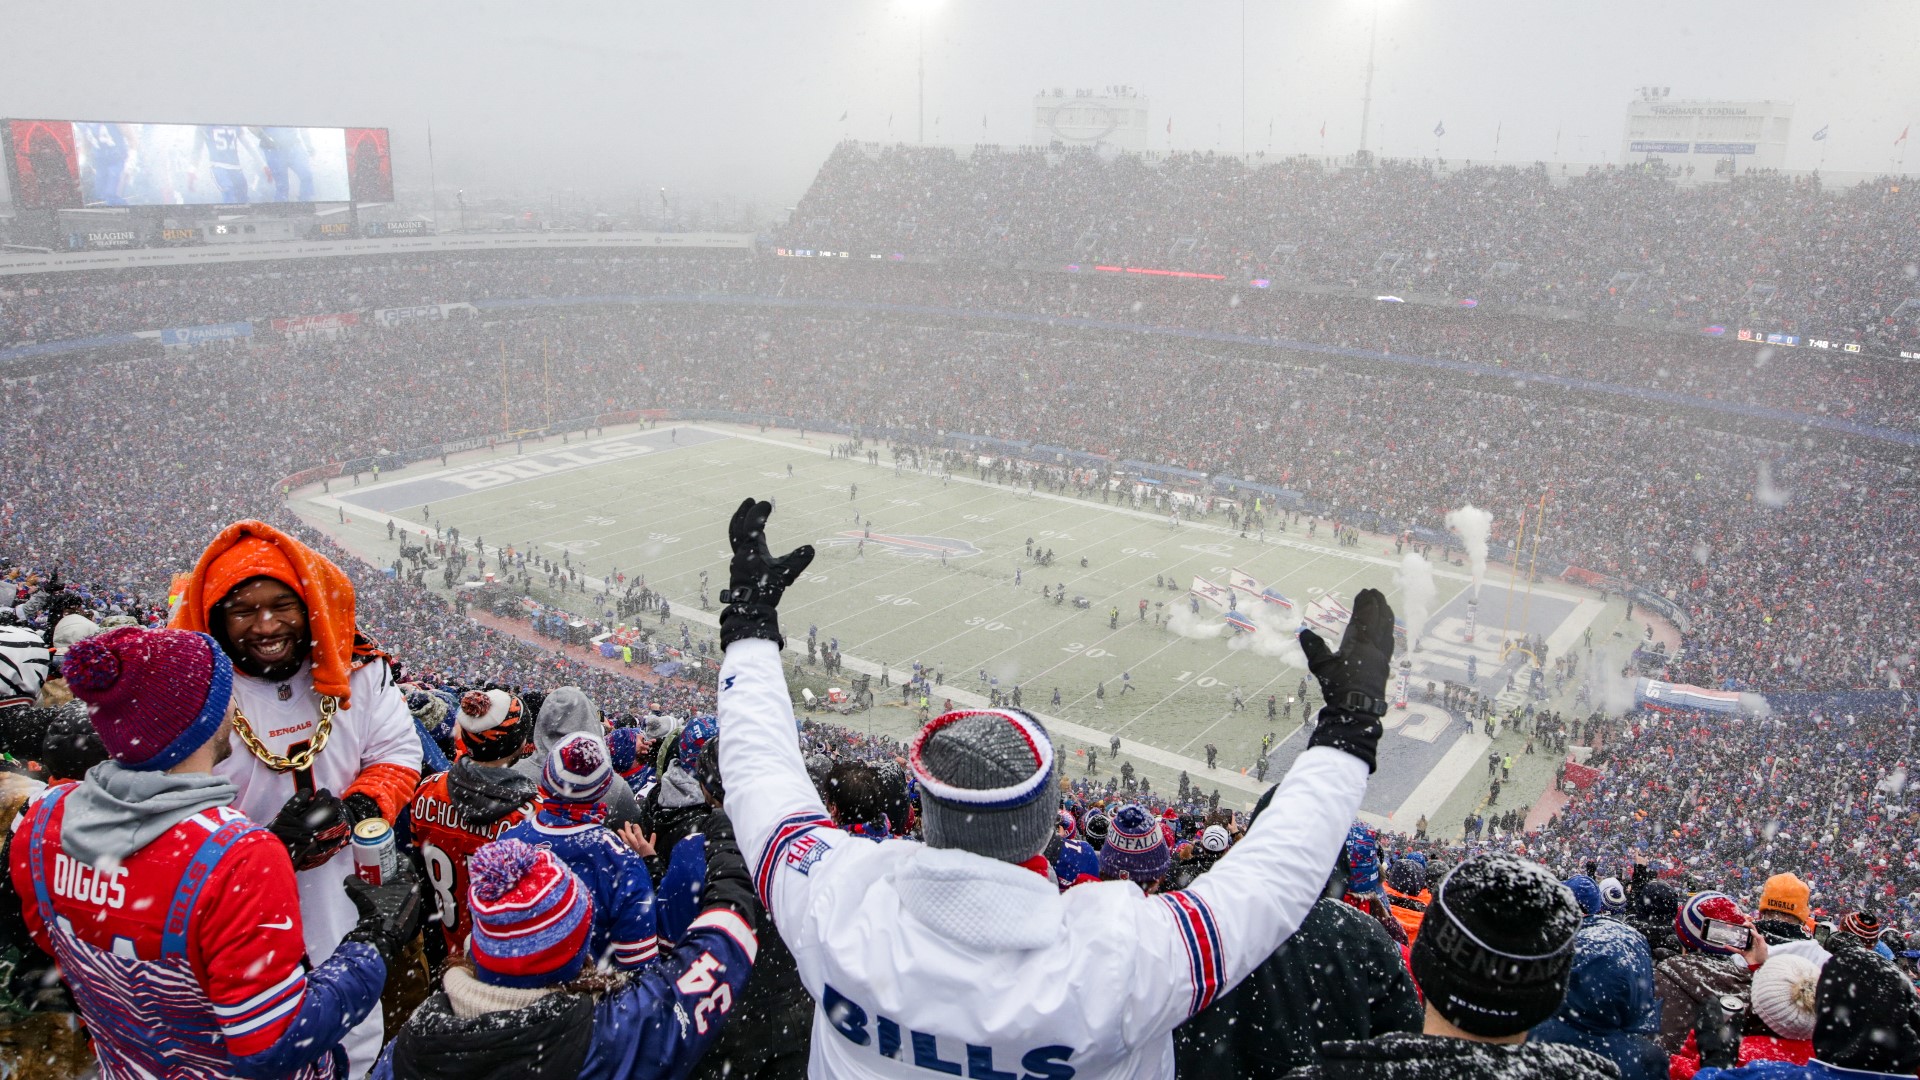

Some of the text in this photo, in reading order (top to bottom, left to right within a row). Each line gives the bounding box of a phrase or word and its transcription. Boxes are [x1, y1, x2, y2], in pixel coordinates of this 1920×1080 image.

[1707, 107, 1746, 115] STADIUM
[213, 128, 237, 150] 57
[216, 225, 227, 234] 25
[320, 224, 347, 233] HUNT
[388, 221, 422, 229] IMAGINE
[89, 231, 135, 241] IMAGINE
[384, 305, 441, 321] GEICO
[192, 326, 238, 339] FANDUEL
[1809, 339, 1829, 349] 7:48
[439, 441, 655, 489] BILLS
[965, 616, 1005, 631] 30
[1062, 642, 1107, 658] 20
[1172, 670, 1218, 687] 10
[269, 720, 312, 738] BENGALS
[786, 834, 818, 864] NFL
[53, 852, 129, 909] DIGGS
[168, 861, 208, 936] BILLS
[1767, 898, 1795, 911] BENGALS
[1435, 919, 1566, 985] BENGAL
[676, 951, 732, 1035] 34
[1449, 994, 1519, 1017] BENGALS
[823, 984, 1076, 1080] BILLS
